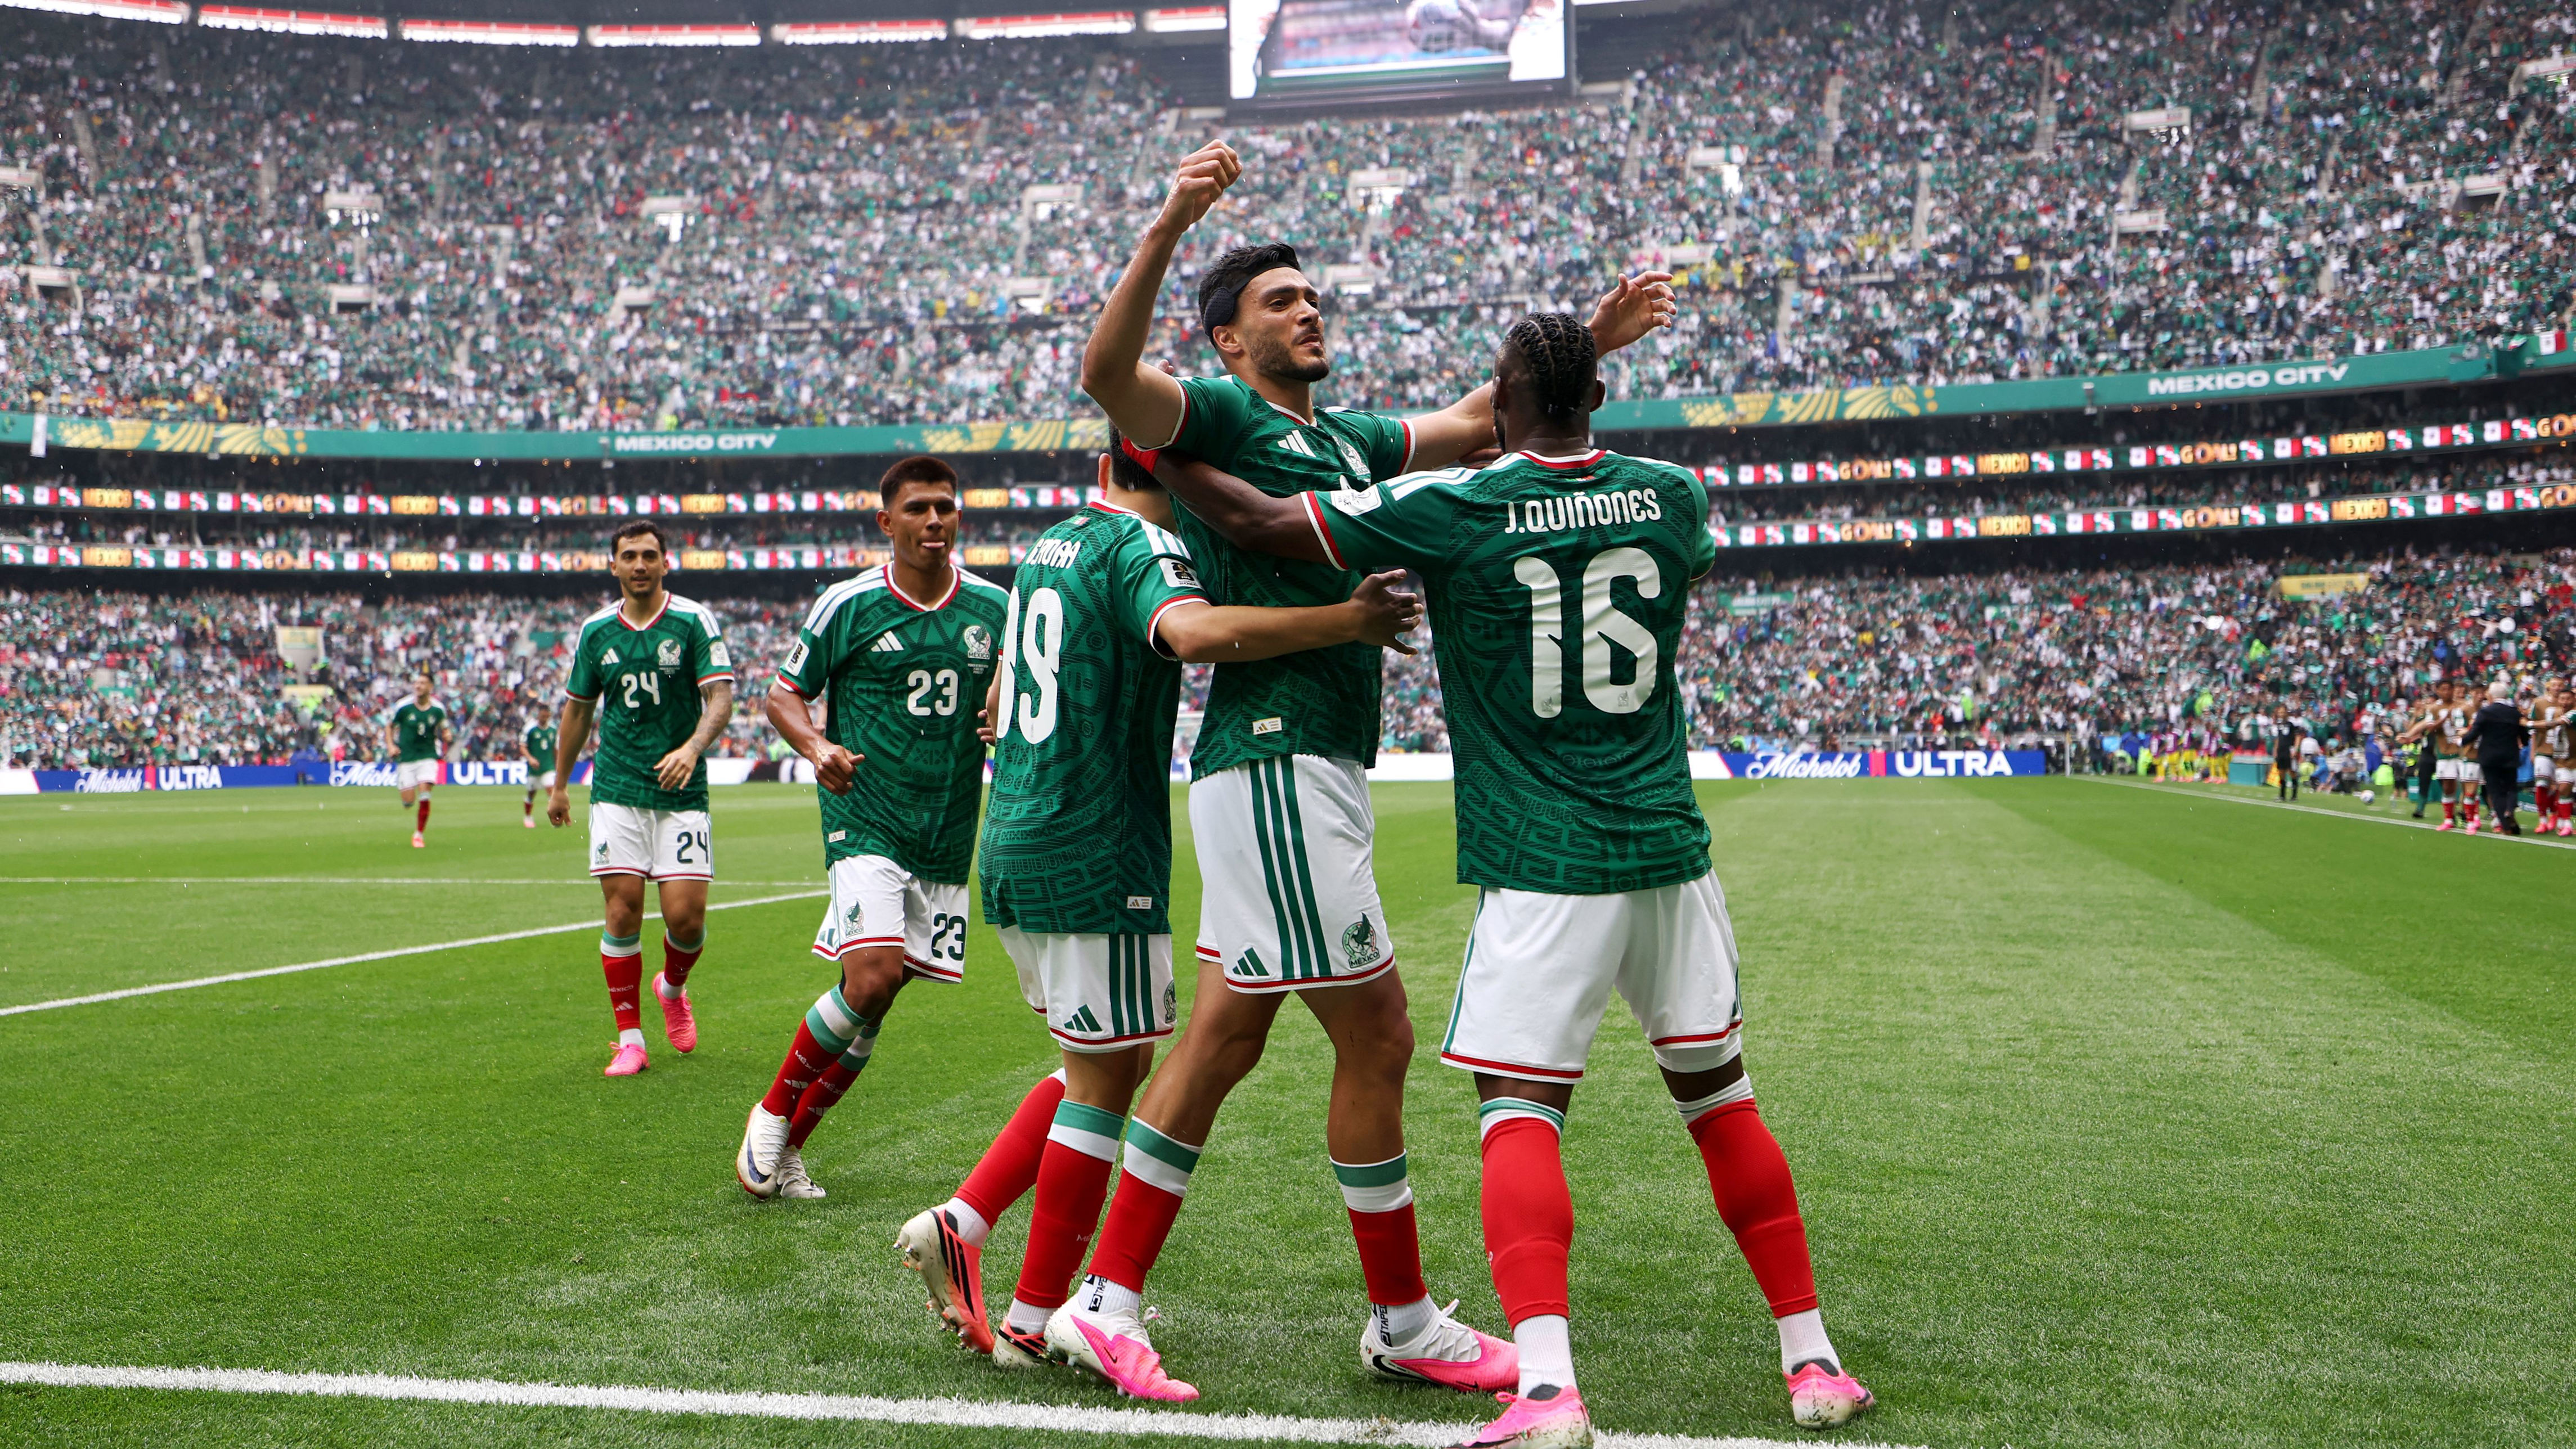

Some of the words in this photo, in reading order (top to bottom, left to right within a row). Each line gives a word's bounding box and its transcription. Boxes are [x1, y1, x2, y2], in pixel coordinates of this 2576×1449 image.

[2148, 370, 2270, 394] MEXICO
[2274, 363, 2349, 386] CITY
[615, 434, 714, 451] MEXICO
[717, 433, 776, 449] CITY
[1977, 453, 2029, 475] MEXICO
[1505, 488, 1661, 534] J.QUIÑONES
[1979, 515, 2031, 537] MEXICO
[1514, 547, 1661, 719] 16
[996, 586, 1063, 744] 19
[622, 671, 660, 708] 24
[907, 669, 958, 717] 23
[159, 766, 223, 790] ULTRA
[329, 760, 397, 787] Miche
[453, 762, 528, 786] ULTR
[1746, 751, 1861, 780] Michelob
[1895, 750, 2013, 776] ULTRA
[677, 831, 709, 864] 24
[932, 913, 966, 961] 23
